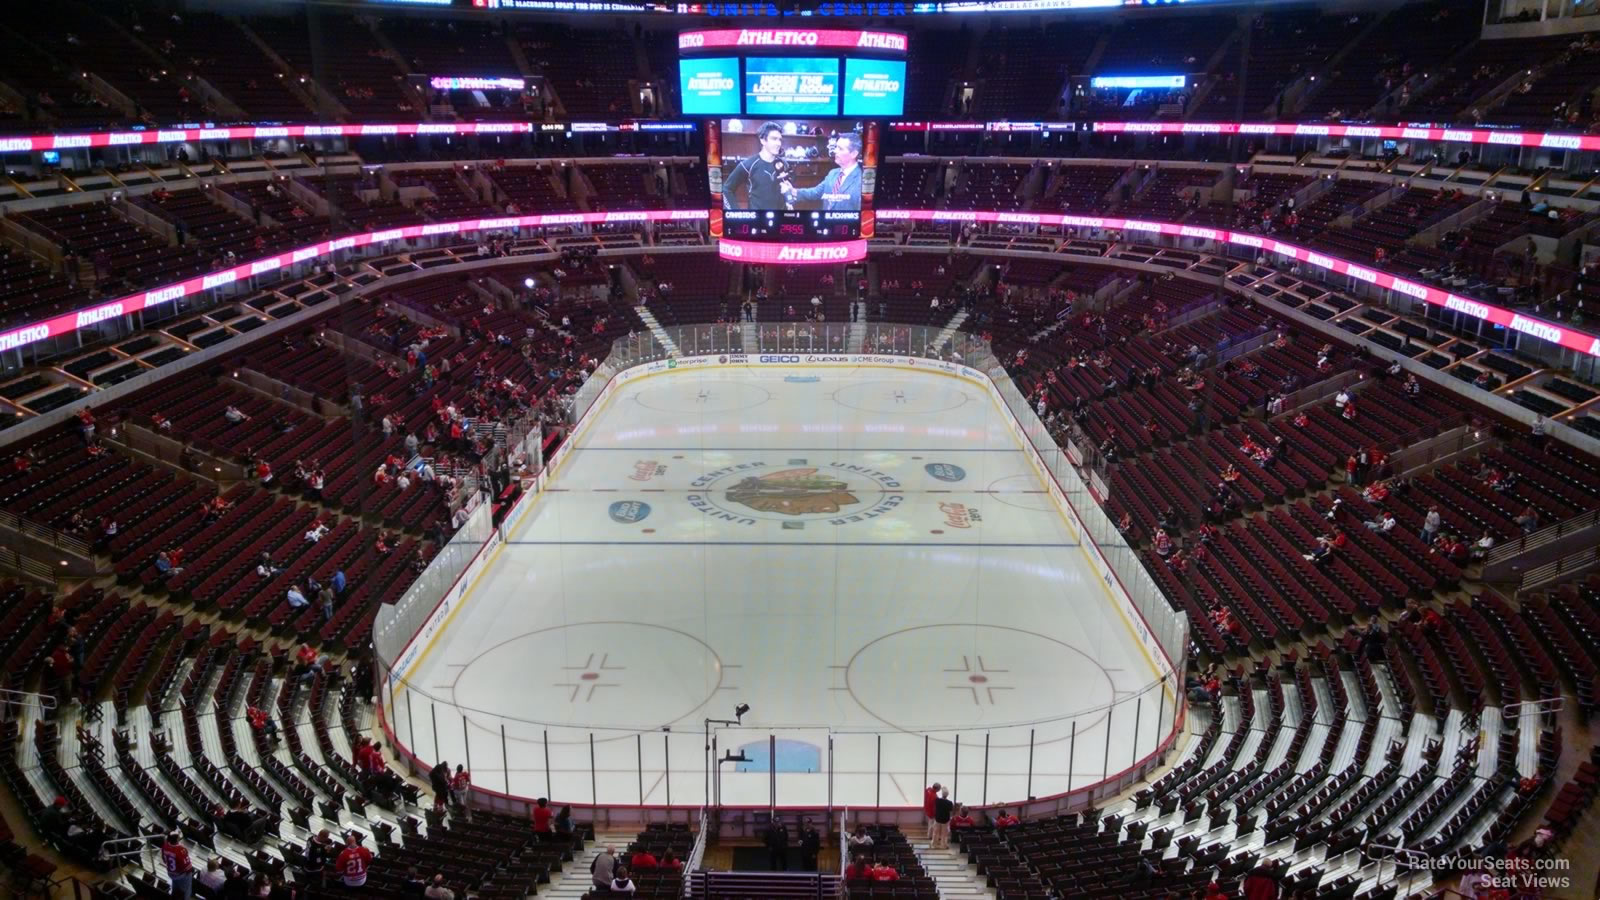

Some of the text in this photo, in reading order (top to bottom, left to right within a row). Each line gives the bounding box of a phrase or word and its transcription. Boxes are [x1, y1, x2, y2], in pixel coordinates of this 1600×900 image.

[819, 3, 906, 16] CENTER
[737, 29, 818, 46] ATHLETICO
[688, 78, 734, 90] ATHLETICO
[753, 83, 833, 93] LOCKER ROOM
[760, 75, 823, 85] INSIDE THE
[852, 78, 899, 92] ATHLETICO
[54, 136, 92, 148] ATHLETICO
[1488, 131, 1523, 145] ATHLETICO
[1541, 133, 1580, 149] ATHLETICO
[932, 210, 976, 220] ATHLETICO
[778, 246, 849, 260] ATHLETICO
[144, 285, 185, 307] ATHLETICO
[1391, 276, 1428, 300] ATHLETICO
[1445, 293, 1488, 320] ATHLETICO
[76, 303, 123, 328] ATHLETICO
[1510, 313, 1561, 343] ATHLETICO
[691, 460, 766, 488] CENTER
[830, 461, 902, 489] UNITED
[687, 494, 758, 527] UNITED
[828, 494, 902, 527] CENTER
[346, 857, 364, 874] 21
